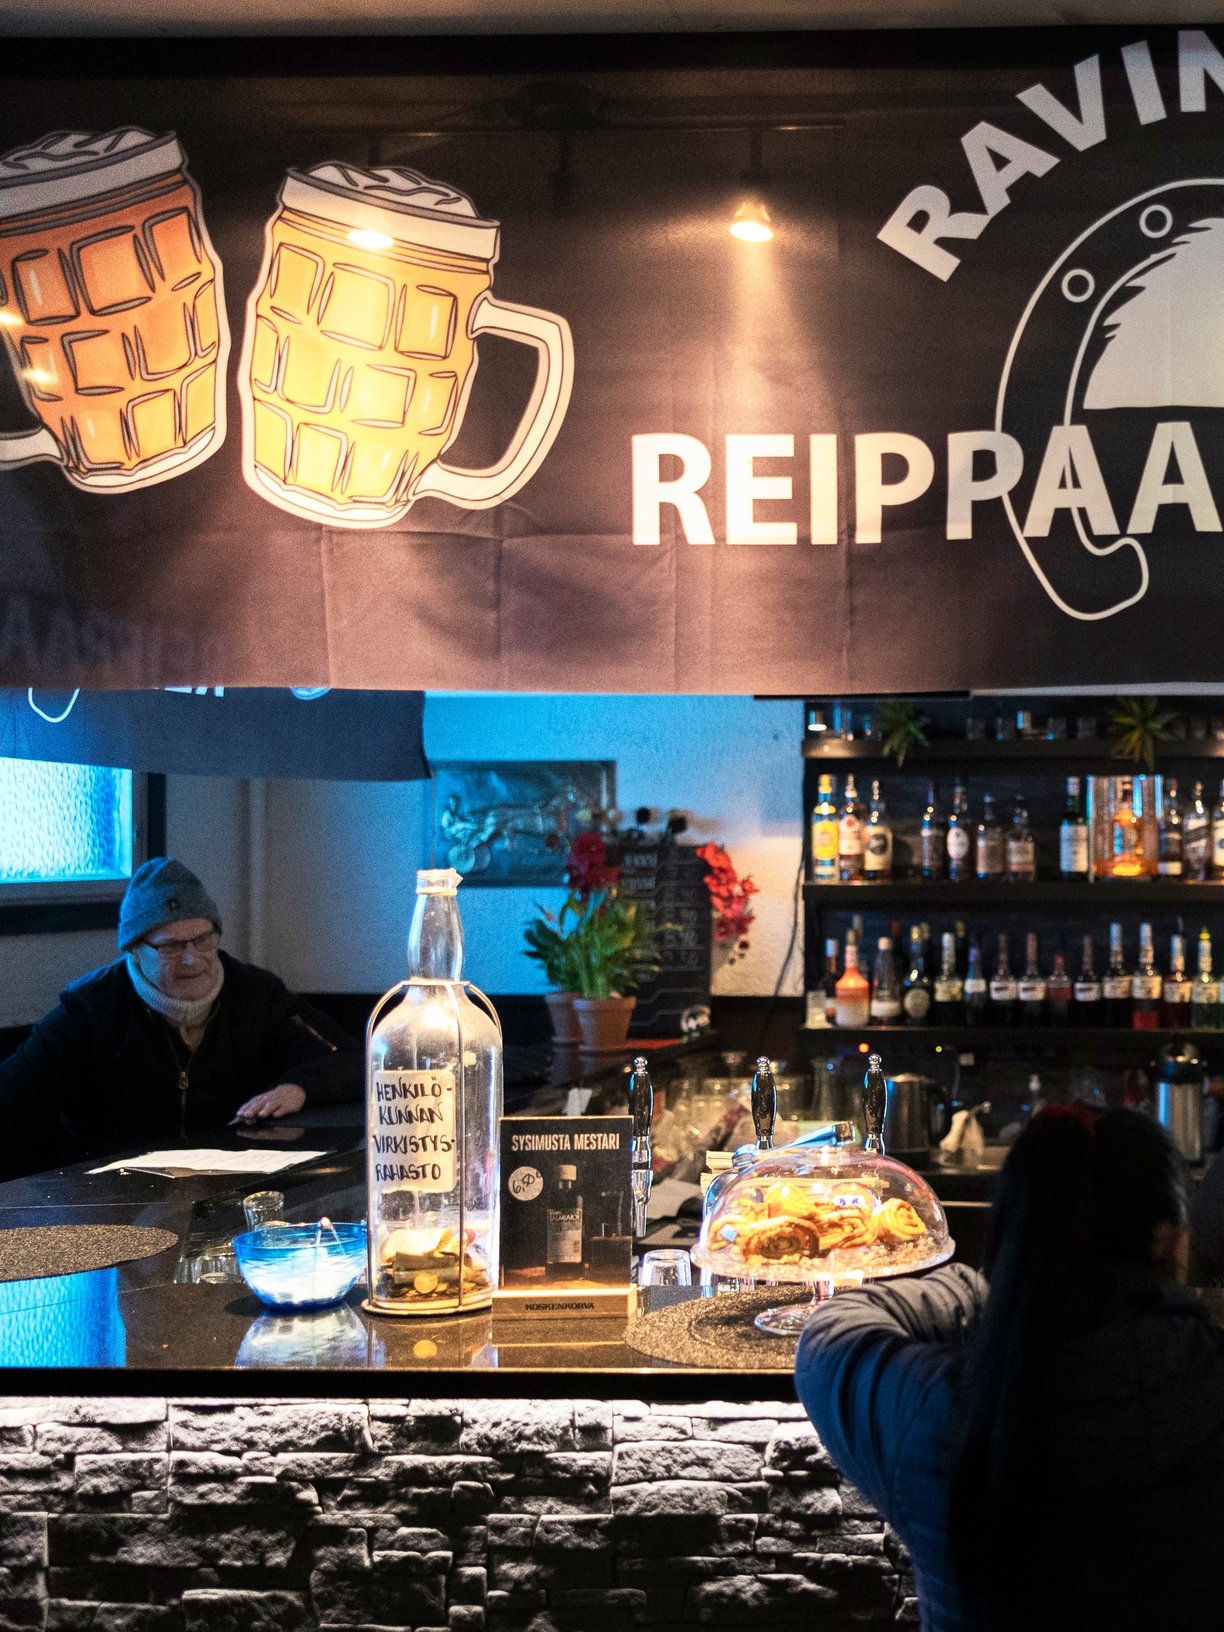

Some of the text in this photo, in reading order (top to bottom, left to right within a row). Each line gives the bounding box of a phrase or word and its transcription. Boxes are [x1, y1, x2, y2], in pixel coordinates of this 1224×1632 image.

[376, 1076, 452, 1102] HENKILÖ-
[379, 1102, 444, 1126] KUNNAN
[512, 1133, 619, 1151] SYSIMUSTA MESTARI
[375, 1163, 441, 1182] RAHASTO
[525, 1302, 595, 1310] KOSKENKORVA
